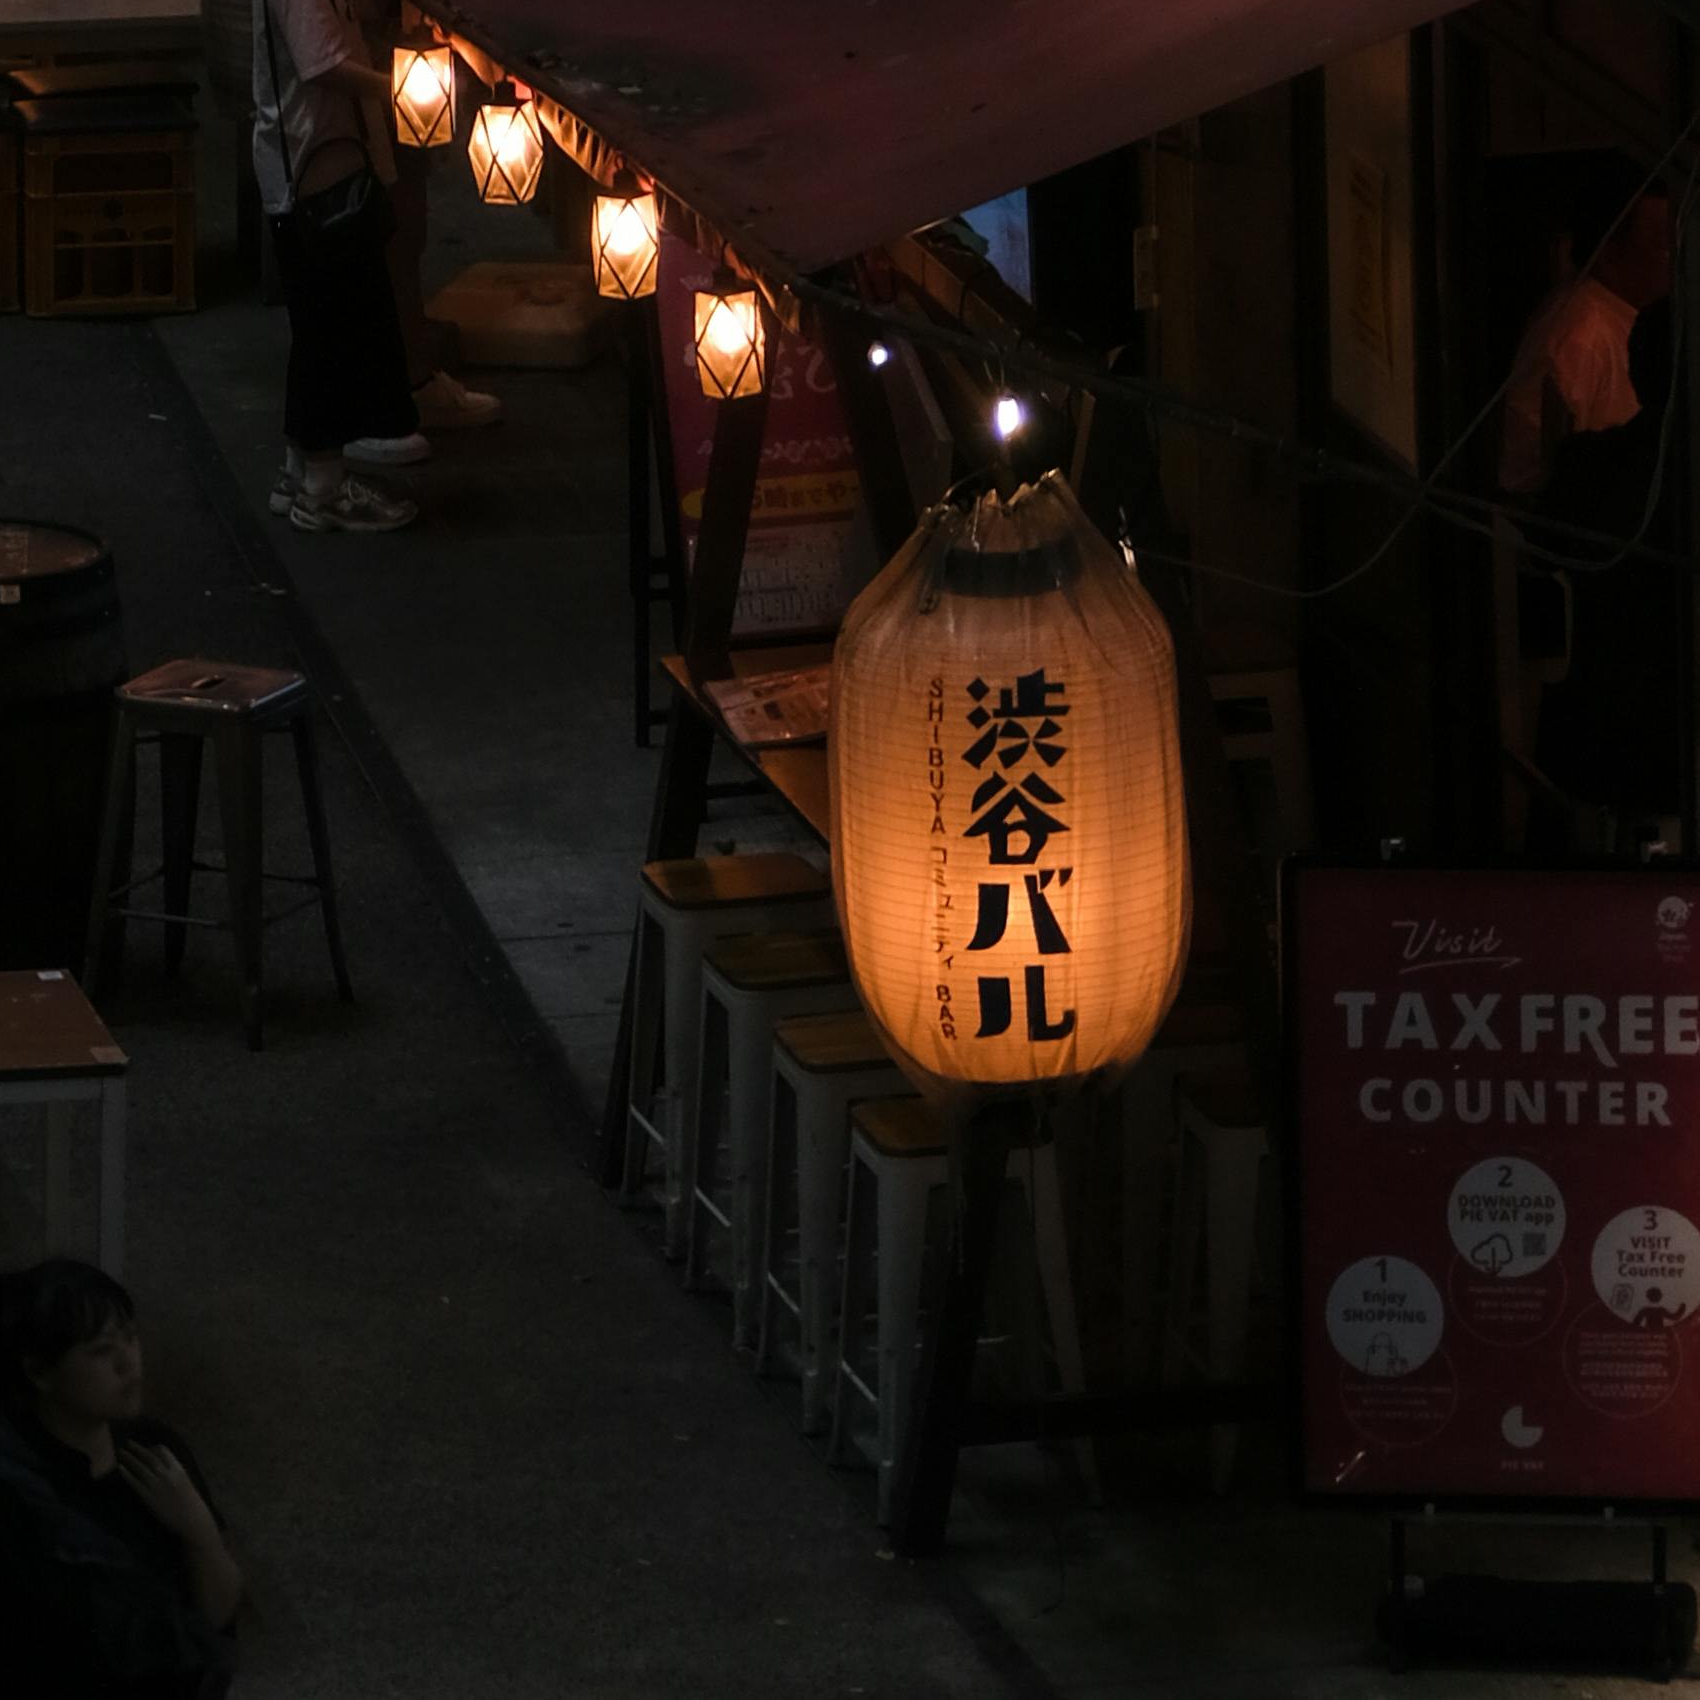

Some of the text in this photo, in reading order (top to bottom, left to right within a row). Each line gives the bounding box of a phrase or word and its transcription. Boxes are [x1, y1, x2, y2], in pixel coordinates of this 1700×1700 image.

[927, 677, 947, 836] SHIBUYA
[961, 667, 1076, 1042] 渋谷バル
[1391, 917, 1505, 960] Visit
[935, 984, 958, 1042] BAR
[1333, 990, 1700, 1069] TAX FREE
[1358, 1076, 1673, 1128] COUNTER
[1498, 1165, 1513, 1188] 2
[1458, 1195, 1556, 1209] DOWNLOAD
[1644, 1209, 1659, 1231] 3
[1630, 1237, 1671, 1250] VISIT
[1617, 1251, 1686, 1264] Tax Free
[1375, 1258, 1387, 1283] 1
[1617, 1264, 1686, 1279] Counter
[1362, 1290, 1407, 1306] Enjoy
[1341, 1309, 1427, 1324] SHOPPING
